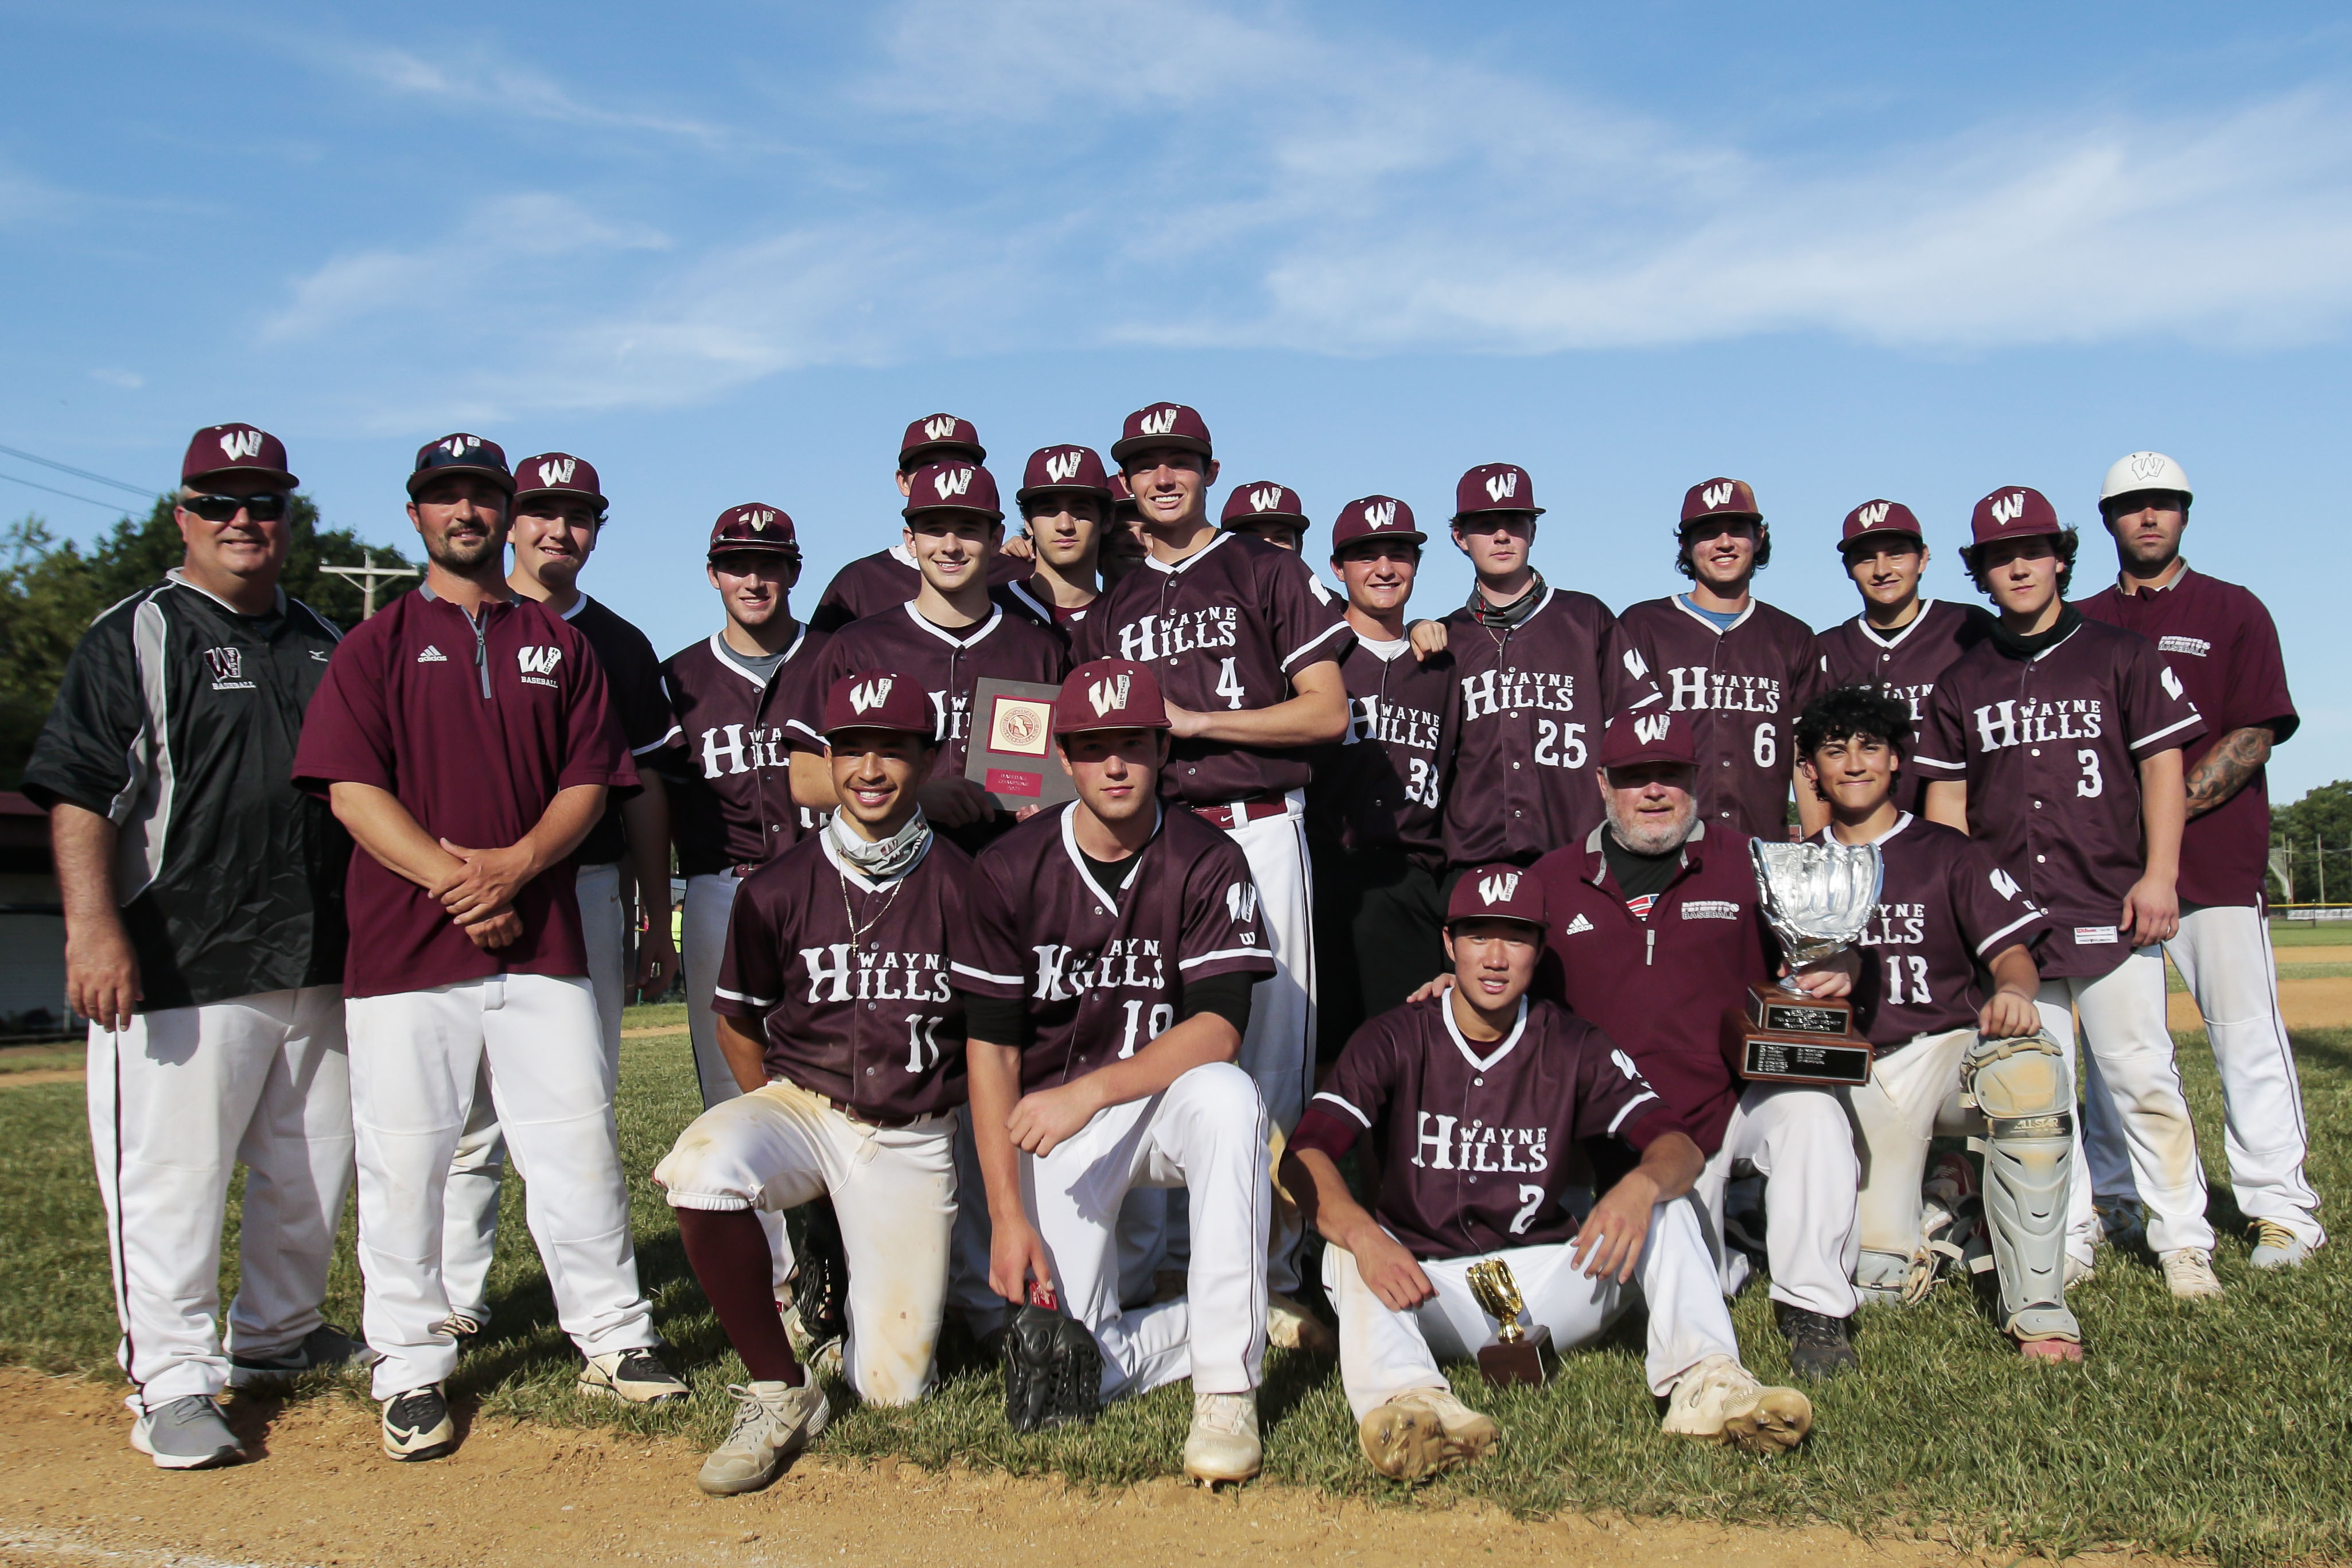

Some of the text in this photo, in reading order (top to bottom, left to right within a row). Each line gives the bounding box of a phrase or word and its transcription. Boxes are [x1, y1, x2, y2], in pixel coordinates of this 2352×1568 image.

[924, 417, 956, 440] W
[1141, 408, 1177, 434] W
[220, 430, 263, 461] W
[538, 459, 576, 487] W
[1047, 452, 1082, 483] W
[2132, 457, 2165, 481] W
[934, 468, 973, 500] W
[1486, 473, 1517, 503] W
[1702, 483, 1734, 509] W
[1250, 487, 1282, 512] W
[1992, 493, 2024, 526] W
[1364, 501, 1396, 530] W
[1859, 503, 1890, 528] W
[1160, 606, 1237, 632] WAYNE
[1118, 614, 1237, 662] HILLS
[2157, 643, 2207, 657] BASEBALL
[204, 647, 242, 682] W
[418, 654, 448, 663] adidas
[518, 645, 562, 675] W
[543, 649, 559, 674] HILLS
[212, 681, 256, 690] BASEBALL
[520, 676, 559, 688] BASEBALL
[877, 679, 891, 706] HILLS
[1118, 676, 1128, 707] HILLS
[1215, 657, 1245, 710] 4
[1461, 669, 1574, 721] HILLS
[1499, 672, 1575, 688] WAYNE
[1667, 666, 1780, 714] HILLS
[1711, 674, 1780, 692] WAYNE
[1883, 683, 1935, 700] AYN
[850, 678, 893, 715] W
[1088, 674, 1131, 718] W
[2019, 699, 2101, 718] WAYNE
[1342, 694, 1440, 750] HILLS
[1380, 703, 1440, 728] WAYNE
[1634, 714, 1670, 745] W
[1973, 699, 2102, 752] HILLS
[701, 723, 790, 779] HIL
[1534, 718, 1588, 769] 25
[1753, 722, 1776, 768] 6
[2076, 749, 2103, 799] 3
[1226, 881, 1257, 924] W
[1478, 873, 1519, 906] W
[1682, 911, 1737, 920] BASEBALL
[1879, 903, 1925, 918] YNE
[1566, 923, 1594, 935] adidas
[1859, 917, 1925, 947] LLS
[799, 943, 951, 1003] HILLS
[857, 951, 949, 971] WAYN
[1032, 944, 1165, 1002] HILLS
[1885, 955, 1933, 1005] 13
[1410, 1110, 1549, 1173] HILLS
[1459, 1127, 1548, 1145] WAYNE
[1509, 1183, 1545, 1235] 2
